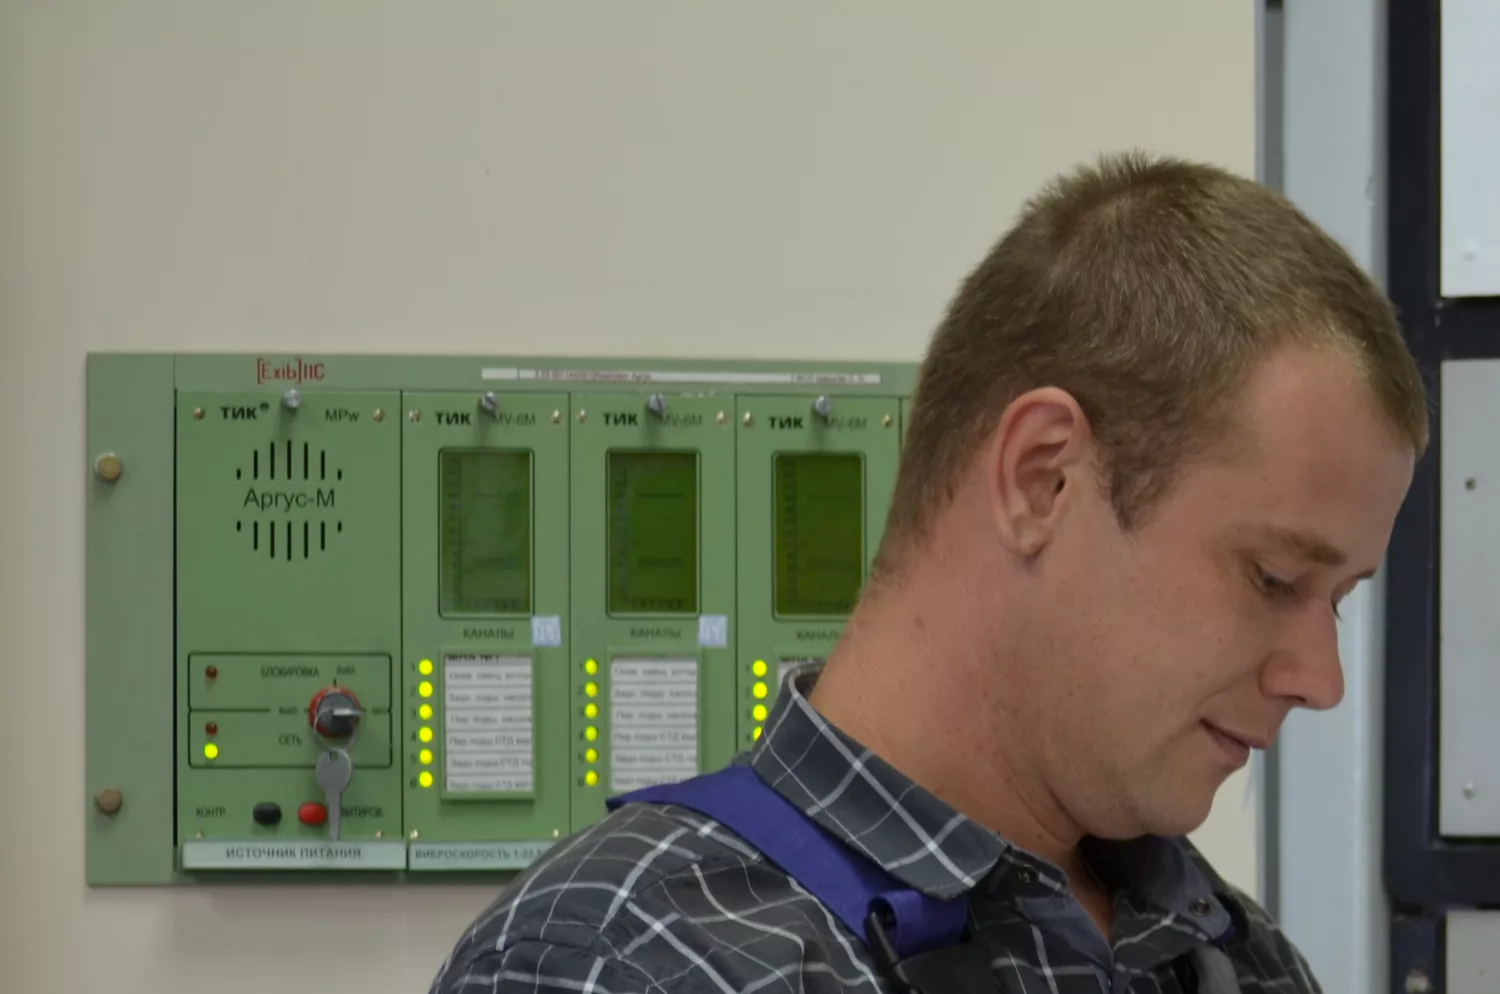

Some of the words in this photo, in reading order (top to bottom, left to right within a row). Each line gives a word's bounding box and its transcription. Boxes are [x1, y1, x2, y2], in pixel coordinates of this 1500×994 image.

[325, 408, 360, 423] MPw
[436, 412, 471, 426] ТИК
[602, 412, 639, 427] ТИК
[768, 416, 804, 430] ТИК
[244, 487, 335, 512] Аргус-М
[463, 628, 515, 640] КАНАЛЫ
[629, 627, 682, 639] КАНАЛЫ
[797, 630, 841, 641] КАНАЛ
[260, 665, 320, 678] БЛОКИРОВКА
[278, 733, 302, 746] СЕТЬ
[226, 848, 296, 860] ИСТОЧНИК
[300, 848, 361, 859] ПИТАНИЯ
[415, 850, 510, 860] ВИБРОСКОРОСТЬ
